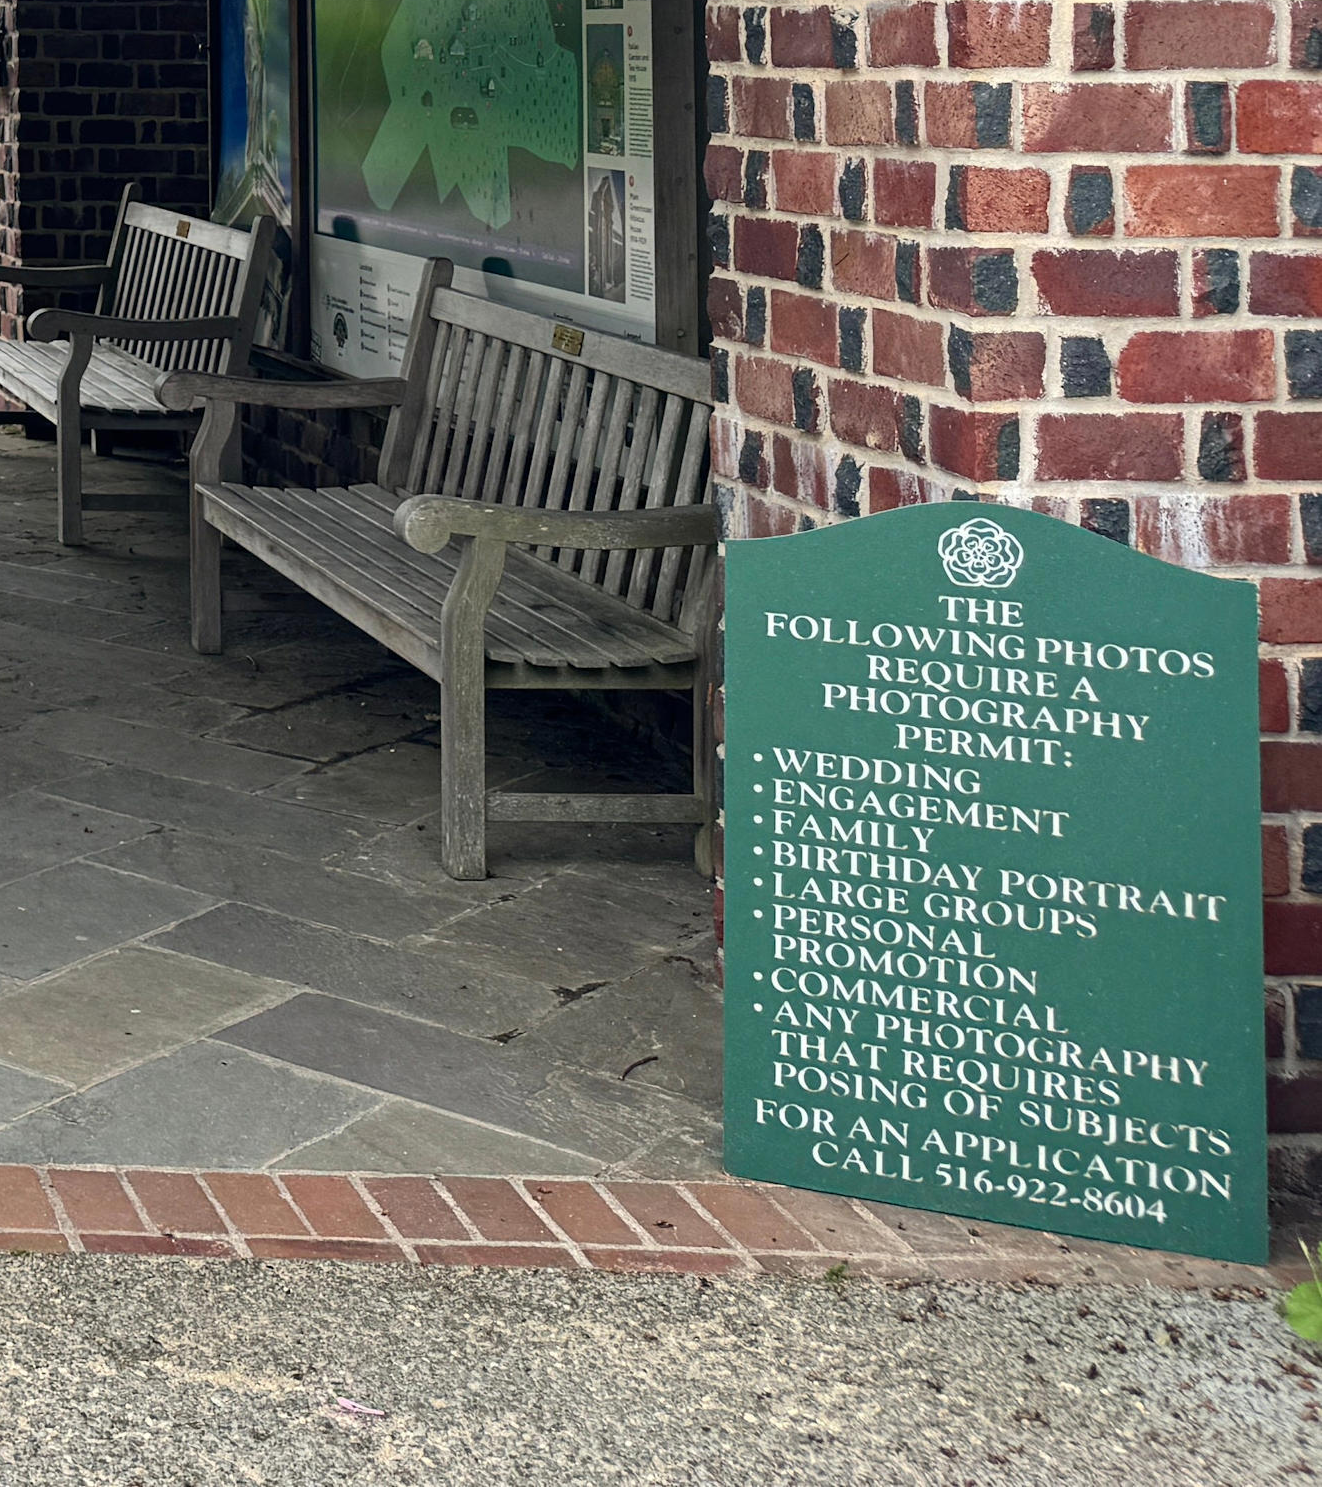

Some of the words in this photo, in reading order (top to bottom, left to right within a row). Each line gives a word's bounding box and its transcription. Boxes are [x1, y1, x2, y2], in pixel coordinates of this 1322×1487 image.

[938, 595, 1024, 627] THE
[765, 612, 1025, 660] FOLLOWING
[1035, 637, 1214, 678] PHOTOS
[866, 654, 1059, 698] REQUIRE
[1070, 676, 1100, 702] A
[822, 683, 1149, 741] PHOTOGRAPHY
[773, 747, 981, 794] WEDDING
[896, 724, 1072, 768] PERMIT:
[772, 809, 934, 853] FAMILY
[773, 778, 1070, 837] ENGAGEMENT
[772, 840, 982, 891] BIRTHDAY
[1000, 869, 1226, 921] PORTRAIT
[773, 872, 909, 914] LARGE
[924, 893, 1097, 938] GROUPS
[772, 904, 995, 958] PERSONAL
[773, 934, 1037, 995] PROMOTION
[771, 967, 1068, 1034] COMMERCIAL
[771, 1029, 887, 1071] THAT
[901, 1049, 1120, 1105] REQUIRES
[775, 1001, 859, 1034] ANY
[875, 1013, 1208, 1086] PHOTOGRAPHY
[773, 1061, 927, 1108] POSING
[944, 1090, 1002, 1120] OF
[1019, 1101, 1231, 1155] SUBJECTS
[755, 1098, 836, 1136] FOR
[848, 1116, 909, 1148] AN
[921, 1129, 1230, 1199] APPLICATION
[812, 1141, 923, 1182] CALL
[936, 1163, 1167, 1223] 516-922-8604
